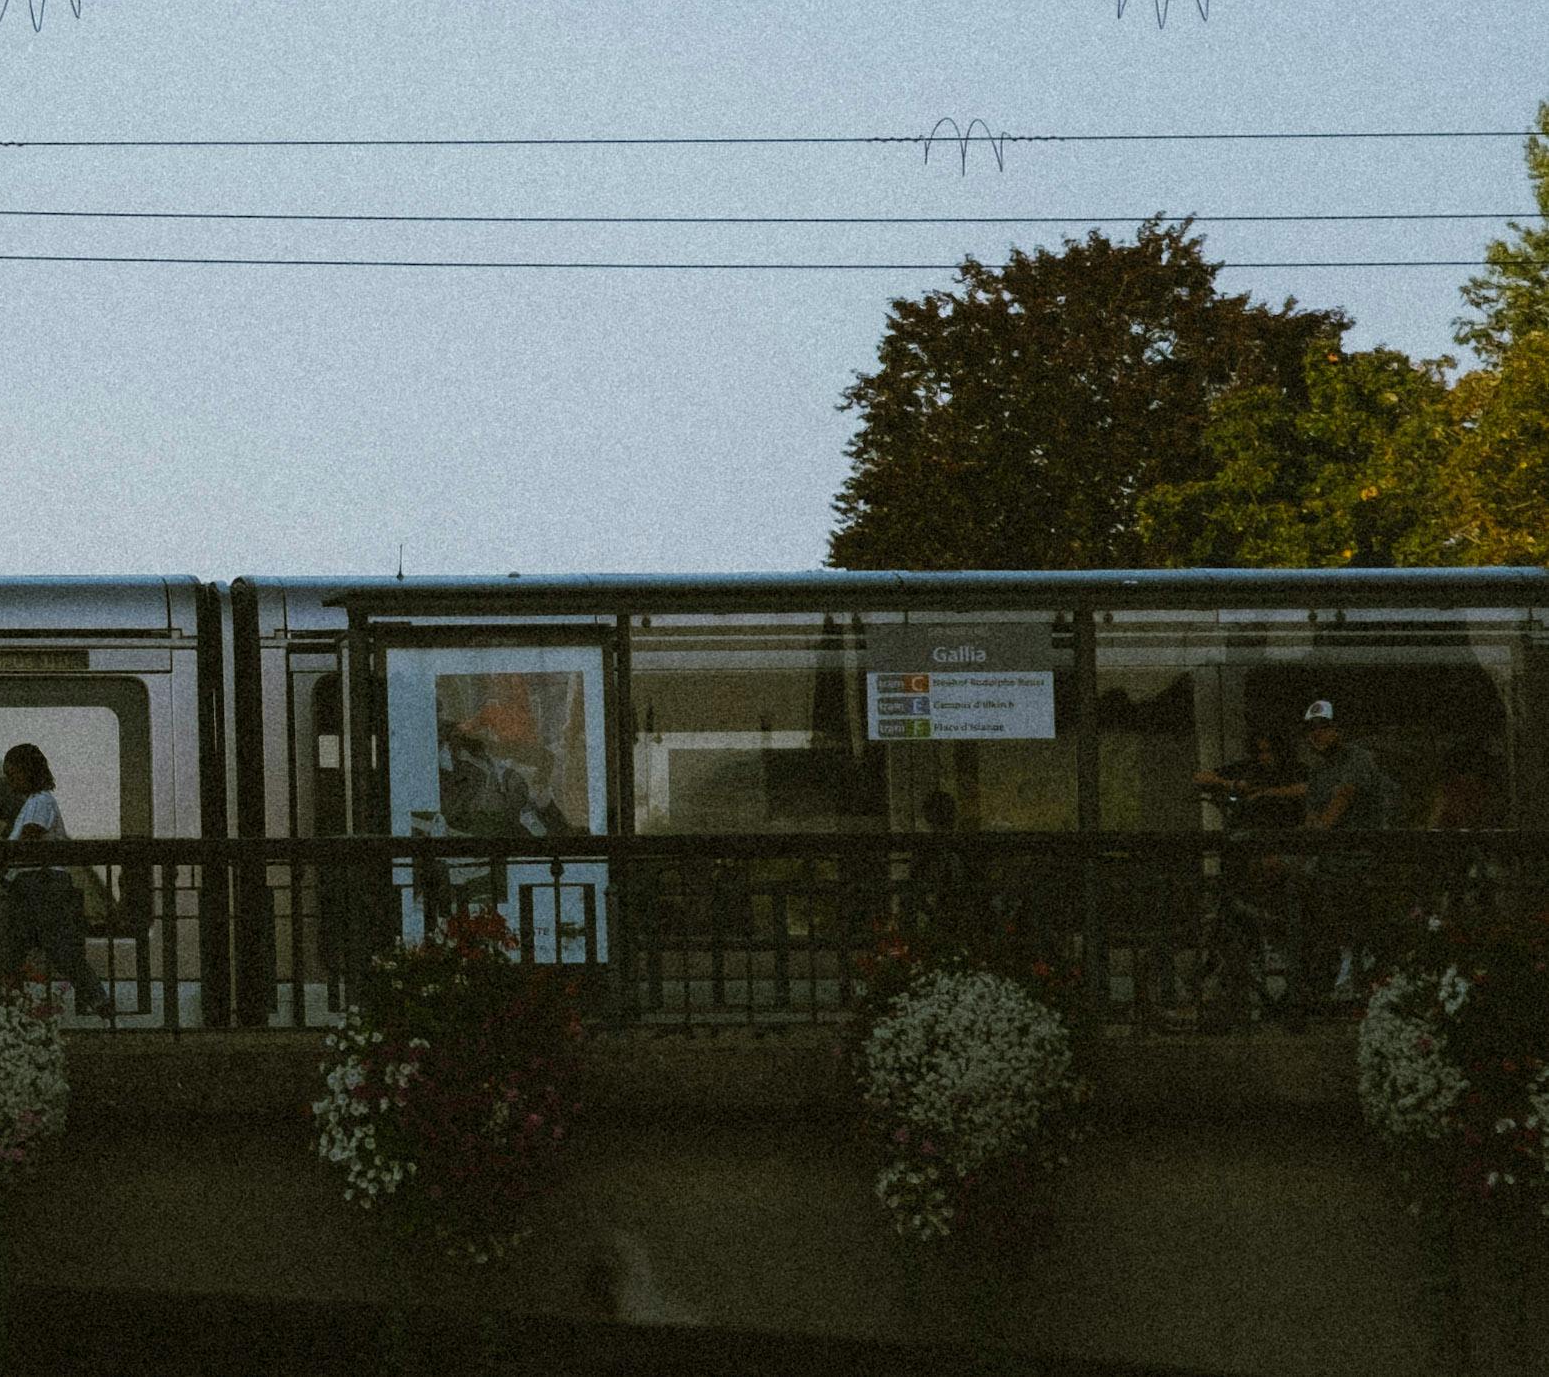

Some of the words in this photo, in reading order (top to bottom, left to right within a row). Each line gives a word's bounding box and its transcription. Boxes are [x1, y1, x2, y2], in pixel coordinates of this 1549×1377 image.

[933, 645, 987, 663] Gallia
[911, 676, 924, 692] C
[912, 698, 924, 714] E
